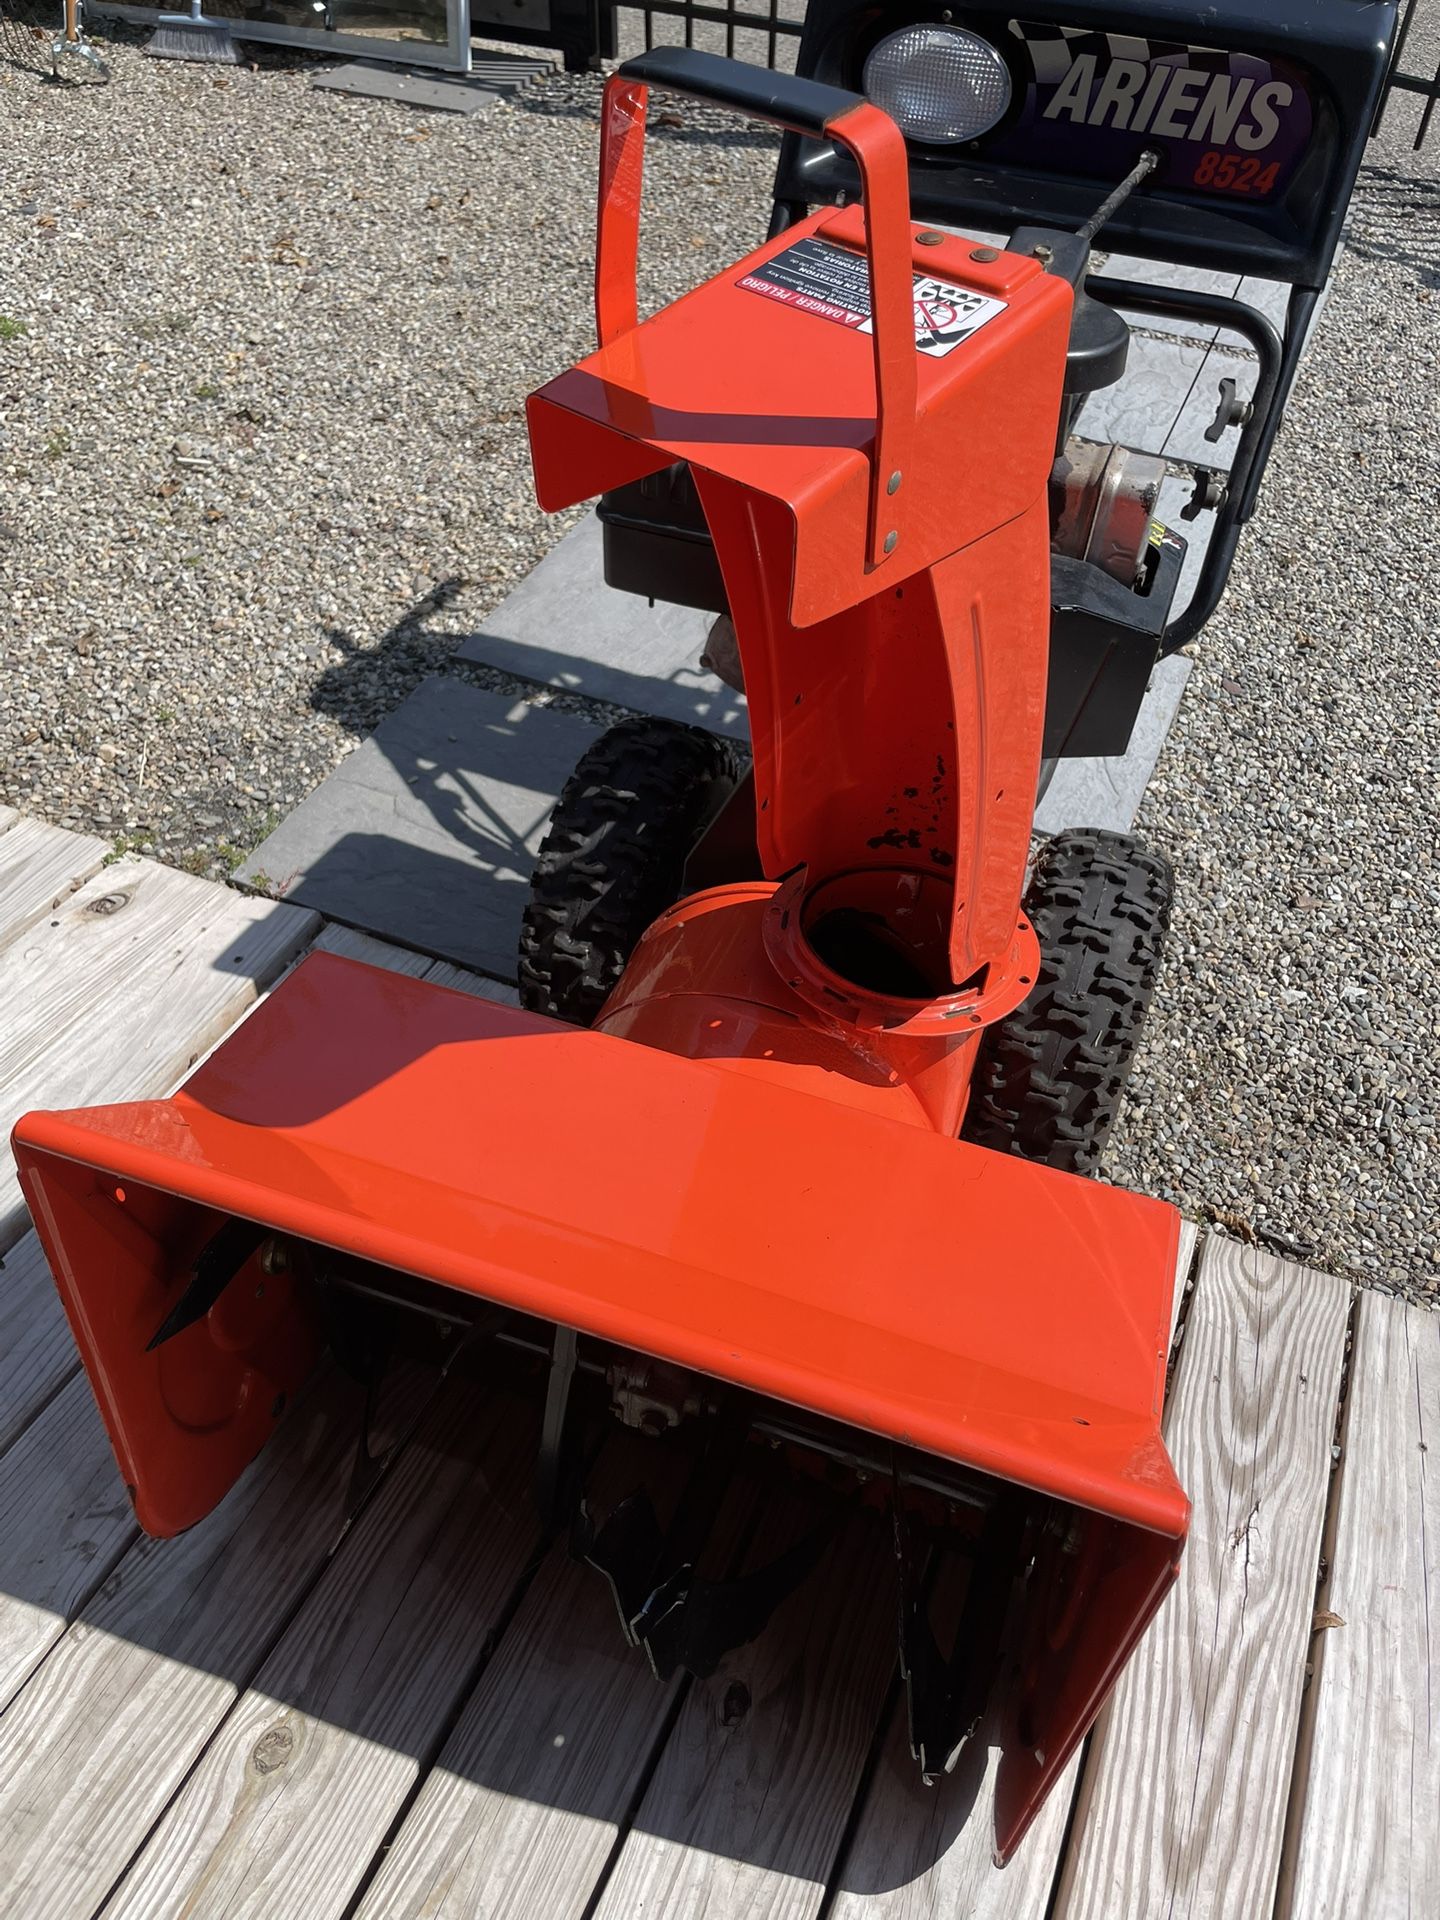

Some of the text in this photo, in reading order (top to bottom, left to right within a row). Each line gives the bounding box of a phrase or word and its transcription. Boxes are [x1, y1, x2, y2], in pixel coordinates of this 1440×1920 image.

[1044, 53, 1294, 152] ARIENS
[1193, 151, 1281, 195] 8524
[822, 255, 871, 274] RATORIAS
[796, 266, 859, 290] EN ROTATION
[739, 277, 846, 318] DANGER / PELIGRO
[793, 285, 827, 299] PARTS
[823, 296, 873, 316] ROTATING
